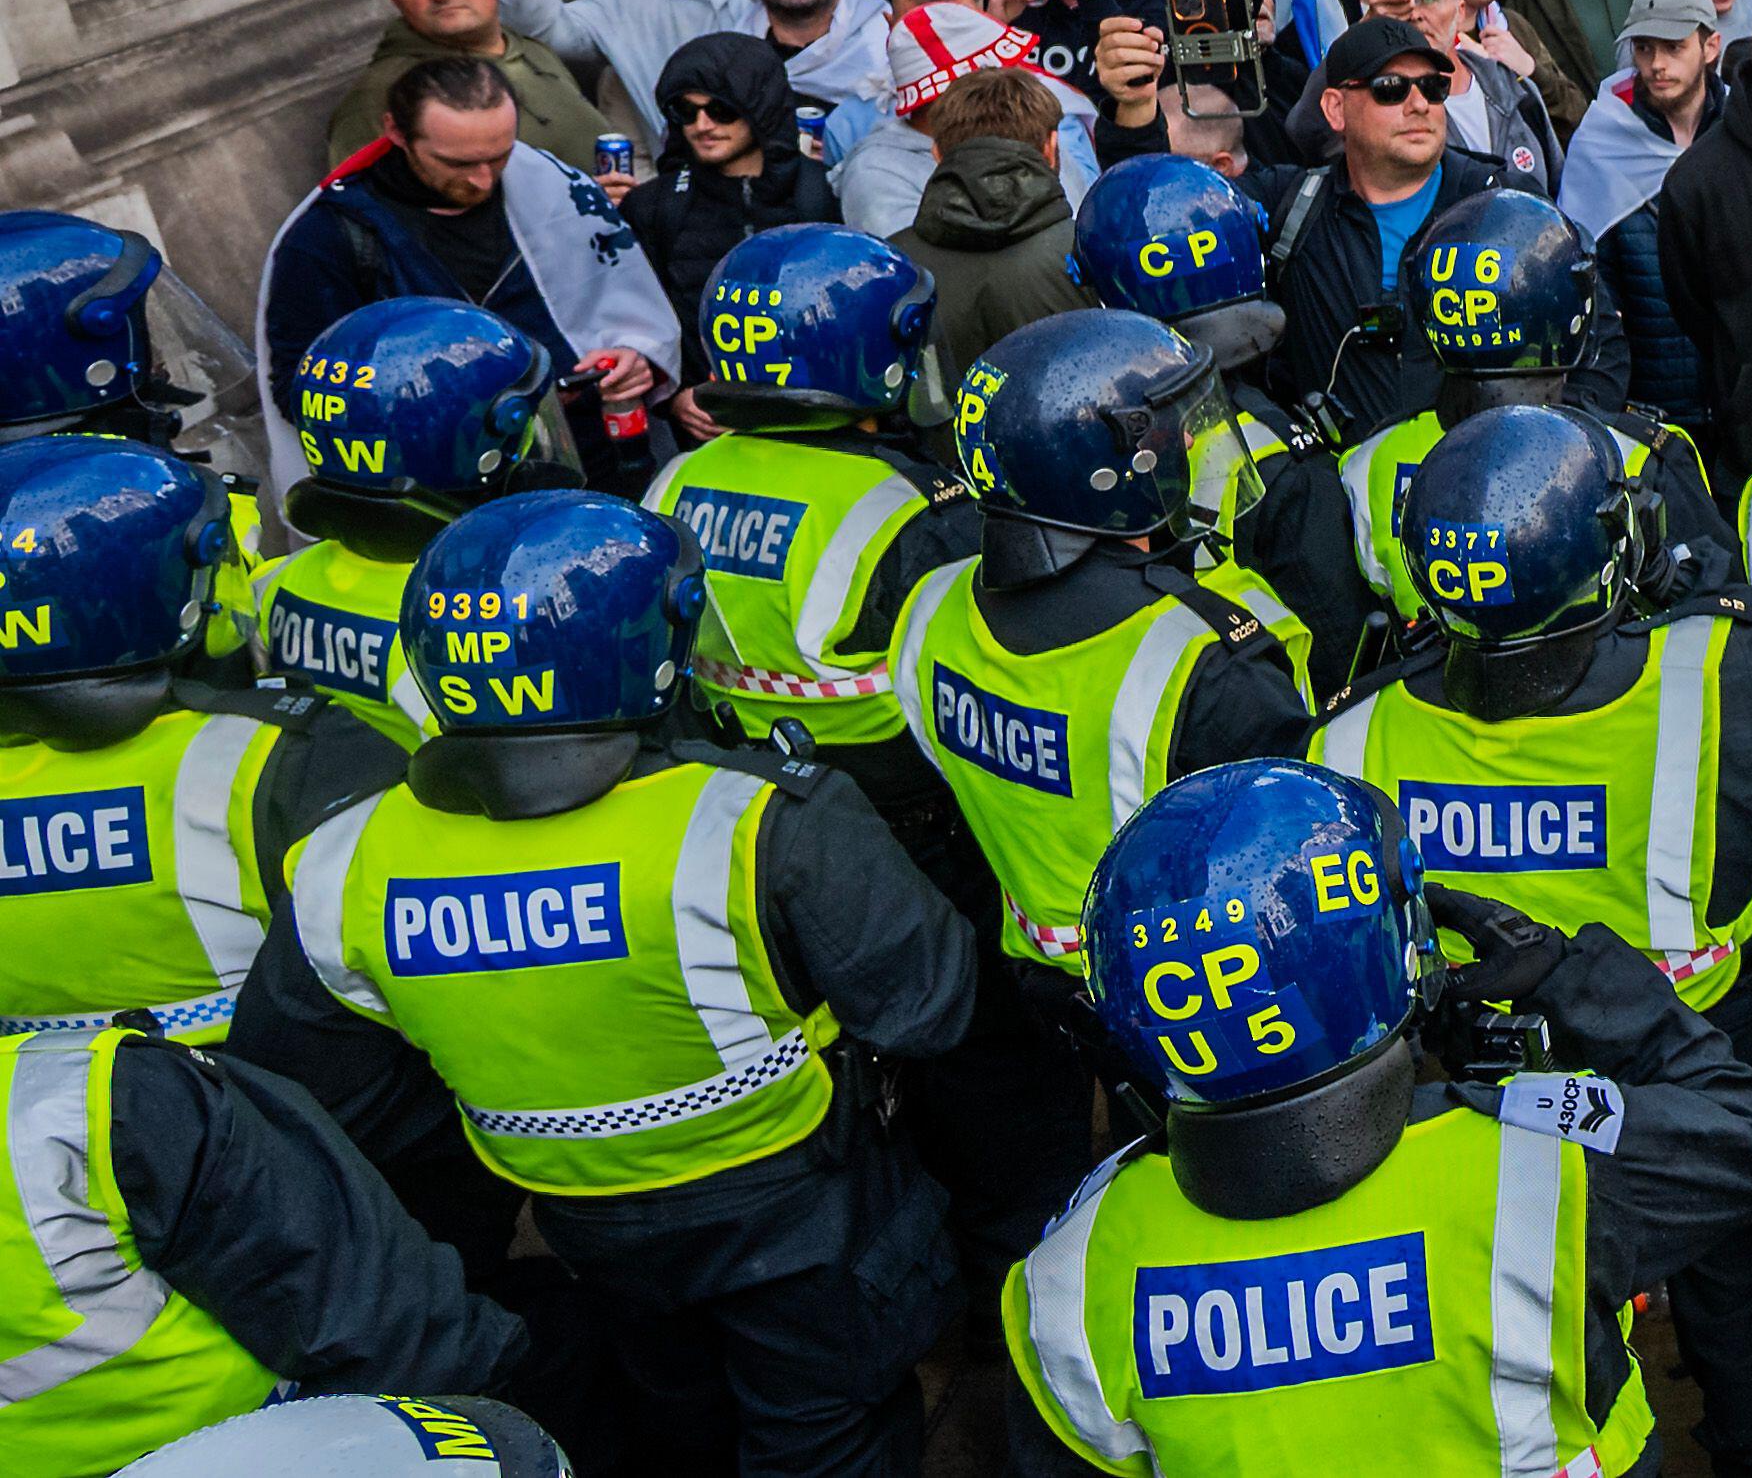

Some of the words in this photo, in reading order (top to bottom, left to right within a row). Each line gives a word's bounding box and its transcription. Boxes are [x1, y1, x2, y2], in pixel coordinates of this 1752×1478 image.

[1431, 247, 1458, 282] U
[1475, 249, 1501, 284] 6
[716, 285, 783, 307] 3469
[1432, 288, 1498, 326] CP
[713, 313, 778, 355] CP
[301, 390, 347, 423] MP
[1430, 527, 1500, 550] 3377
[428, 591, 529, 621] 9391
[1427, 559, 1508, 604] CP
[270, 602, 384, 691] POLICE
[447, 631, 511, 664] MP
[935, 678, 1062, 781] POLICE
[1408, 799, 1597, 856] POLICE
[1311, 848, 1380, 914] EG
[394, 881, 612, 961] POLICE
[1132, 897, 1246, 949] 3249
[1144, 942, 1261, 1022] CP
[1158, 1030, 1218, 1078] U
[1247, 1004, 1298, 1056] 5
[1557, 1077, 1582, 1136] 430CP
[1148, 1260, 1416, 1377] POLICE
